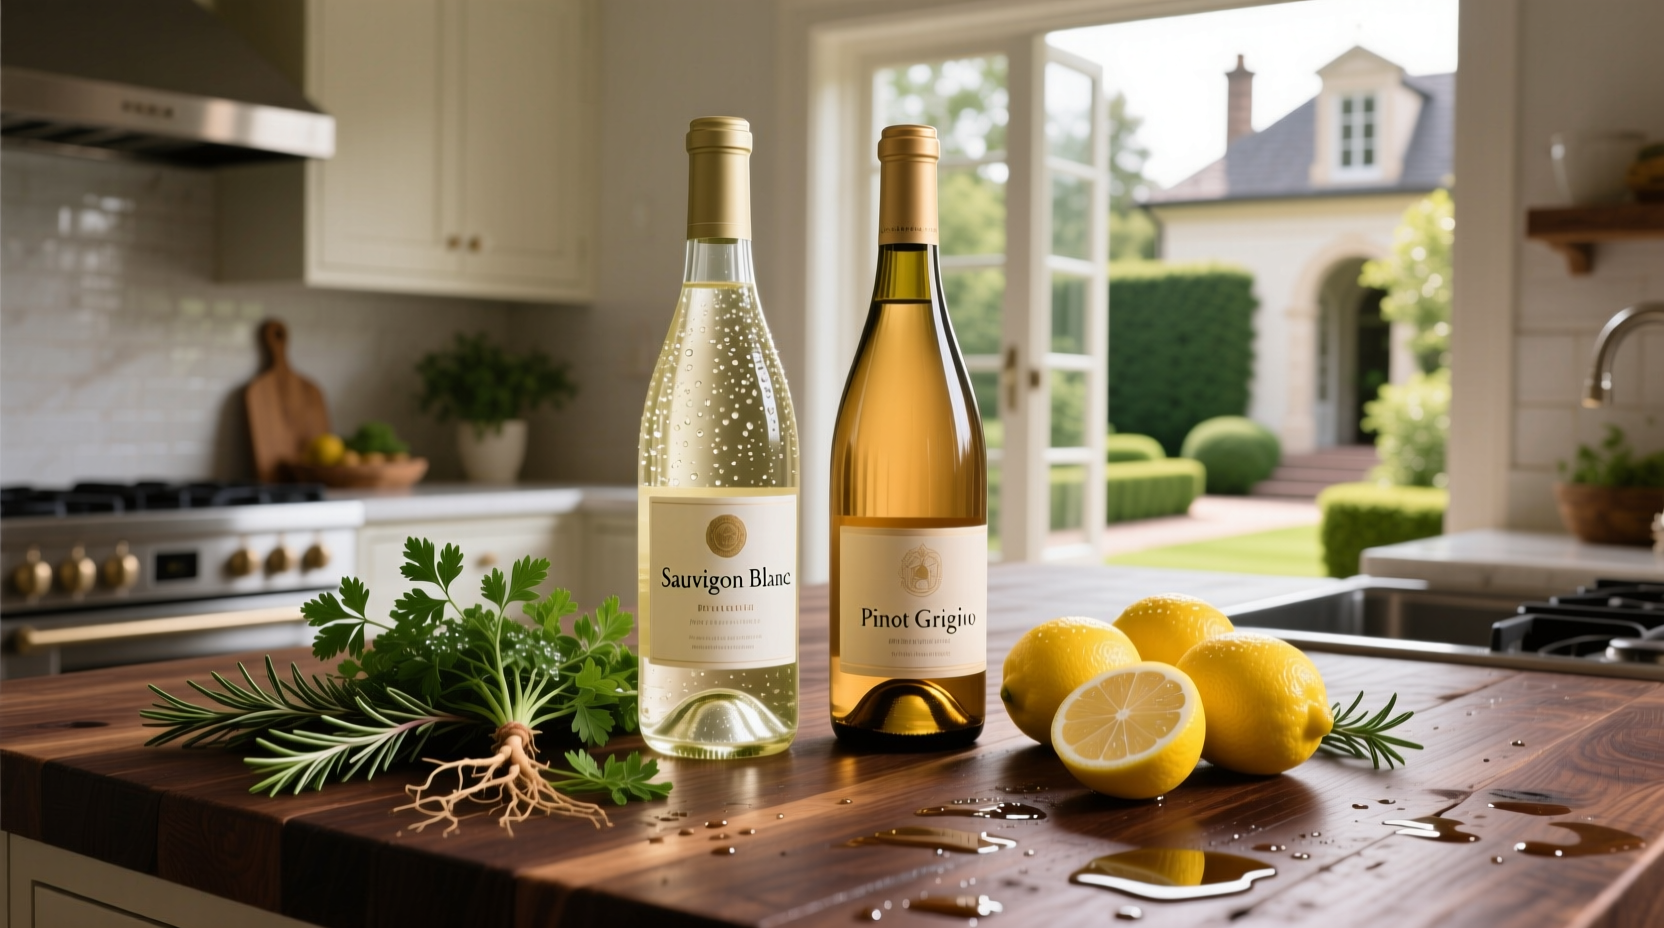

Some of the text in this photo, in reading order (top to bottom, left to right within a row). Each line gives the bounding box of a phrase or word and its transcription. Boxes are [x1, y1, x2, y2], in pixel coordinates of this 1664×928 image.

[661, 566, 791, 596] Sauvigon Blanc
[861, 607, 910, 628] Pinot
